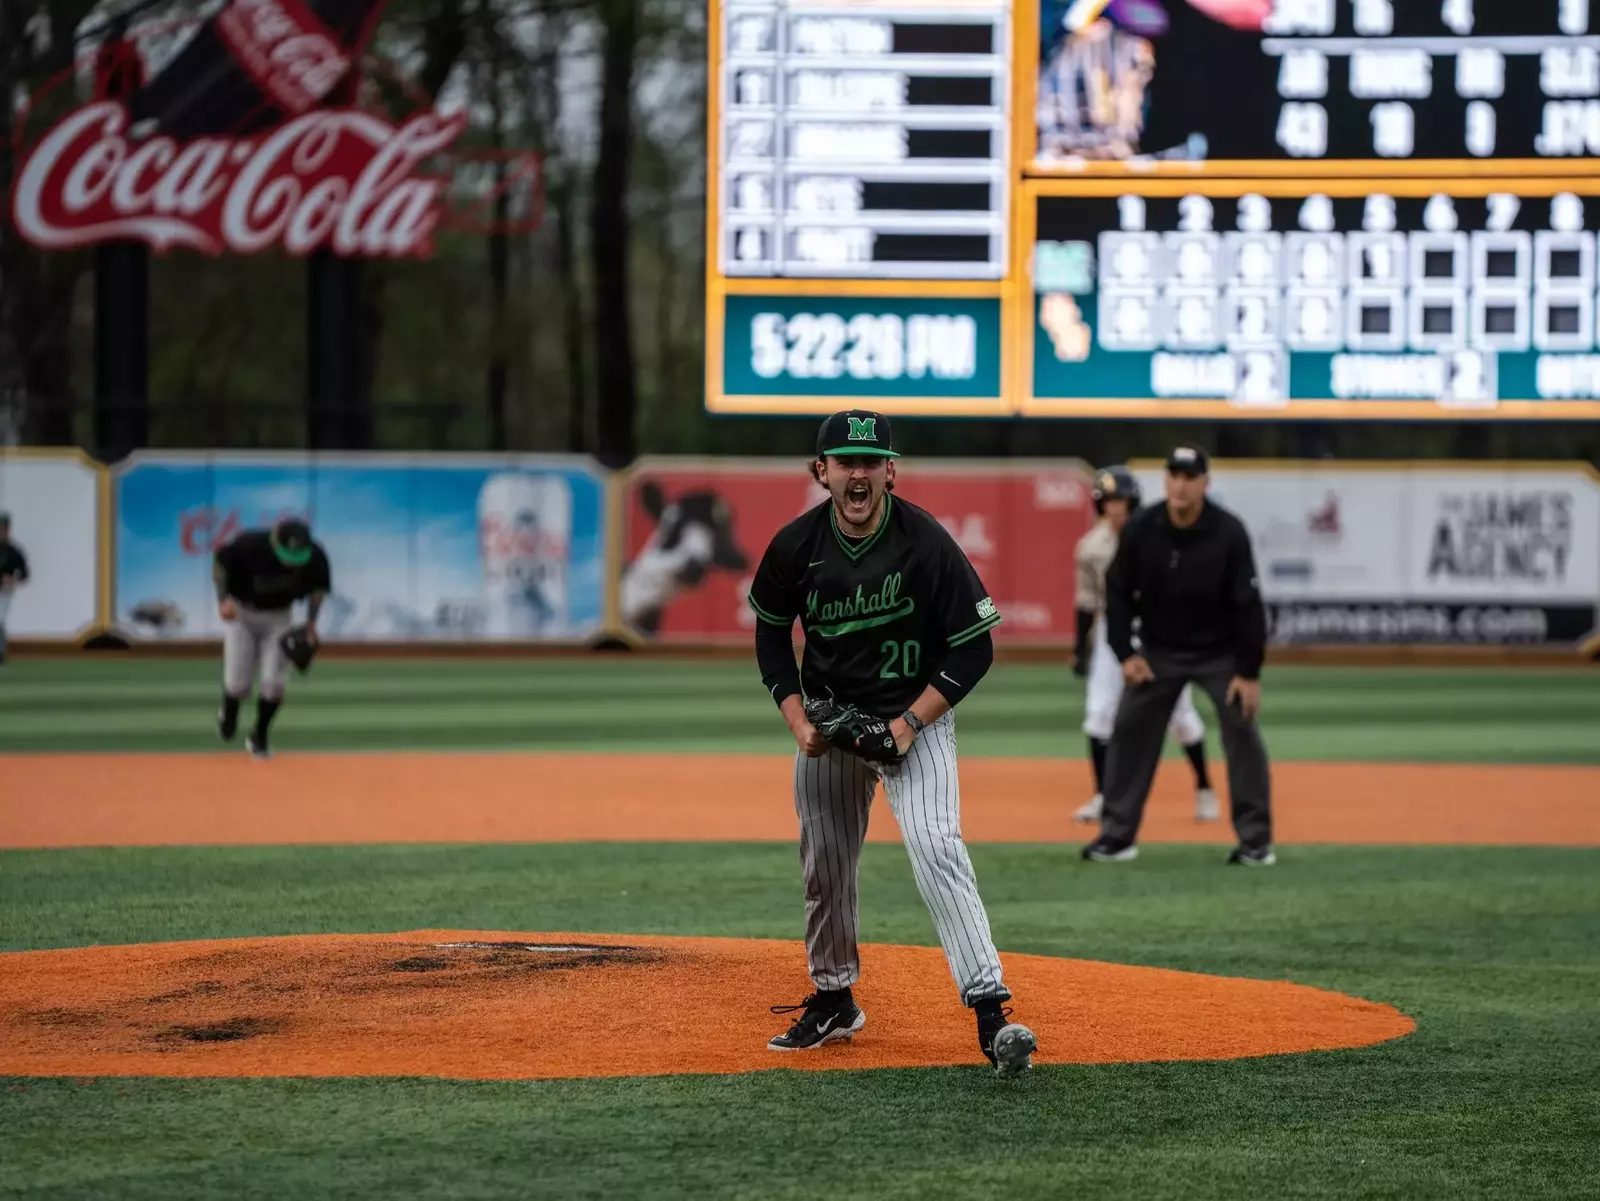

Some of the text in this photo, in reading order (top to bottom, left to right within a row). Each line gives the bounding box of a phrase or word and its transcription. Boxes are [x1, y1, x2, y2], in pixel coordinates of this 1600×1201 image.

[14, 103, 467, 252] Coca-Cola
[1117, 193, 1146, 231] 1
[1237, 193, 1271, 231] 3
[848, 418, 878, 441] M
[806, 572, 907, 624] Marshall
[879, 640, 921, 679] 20
